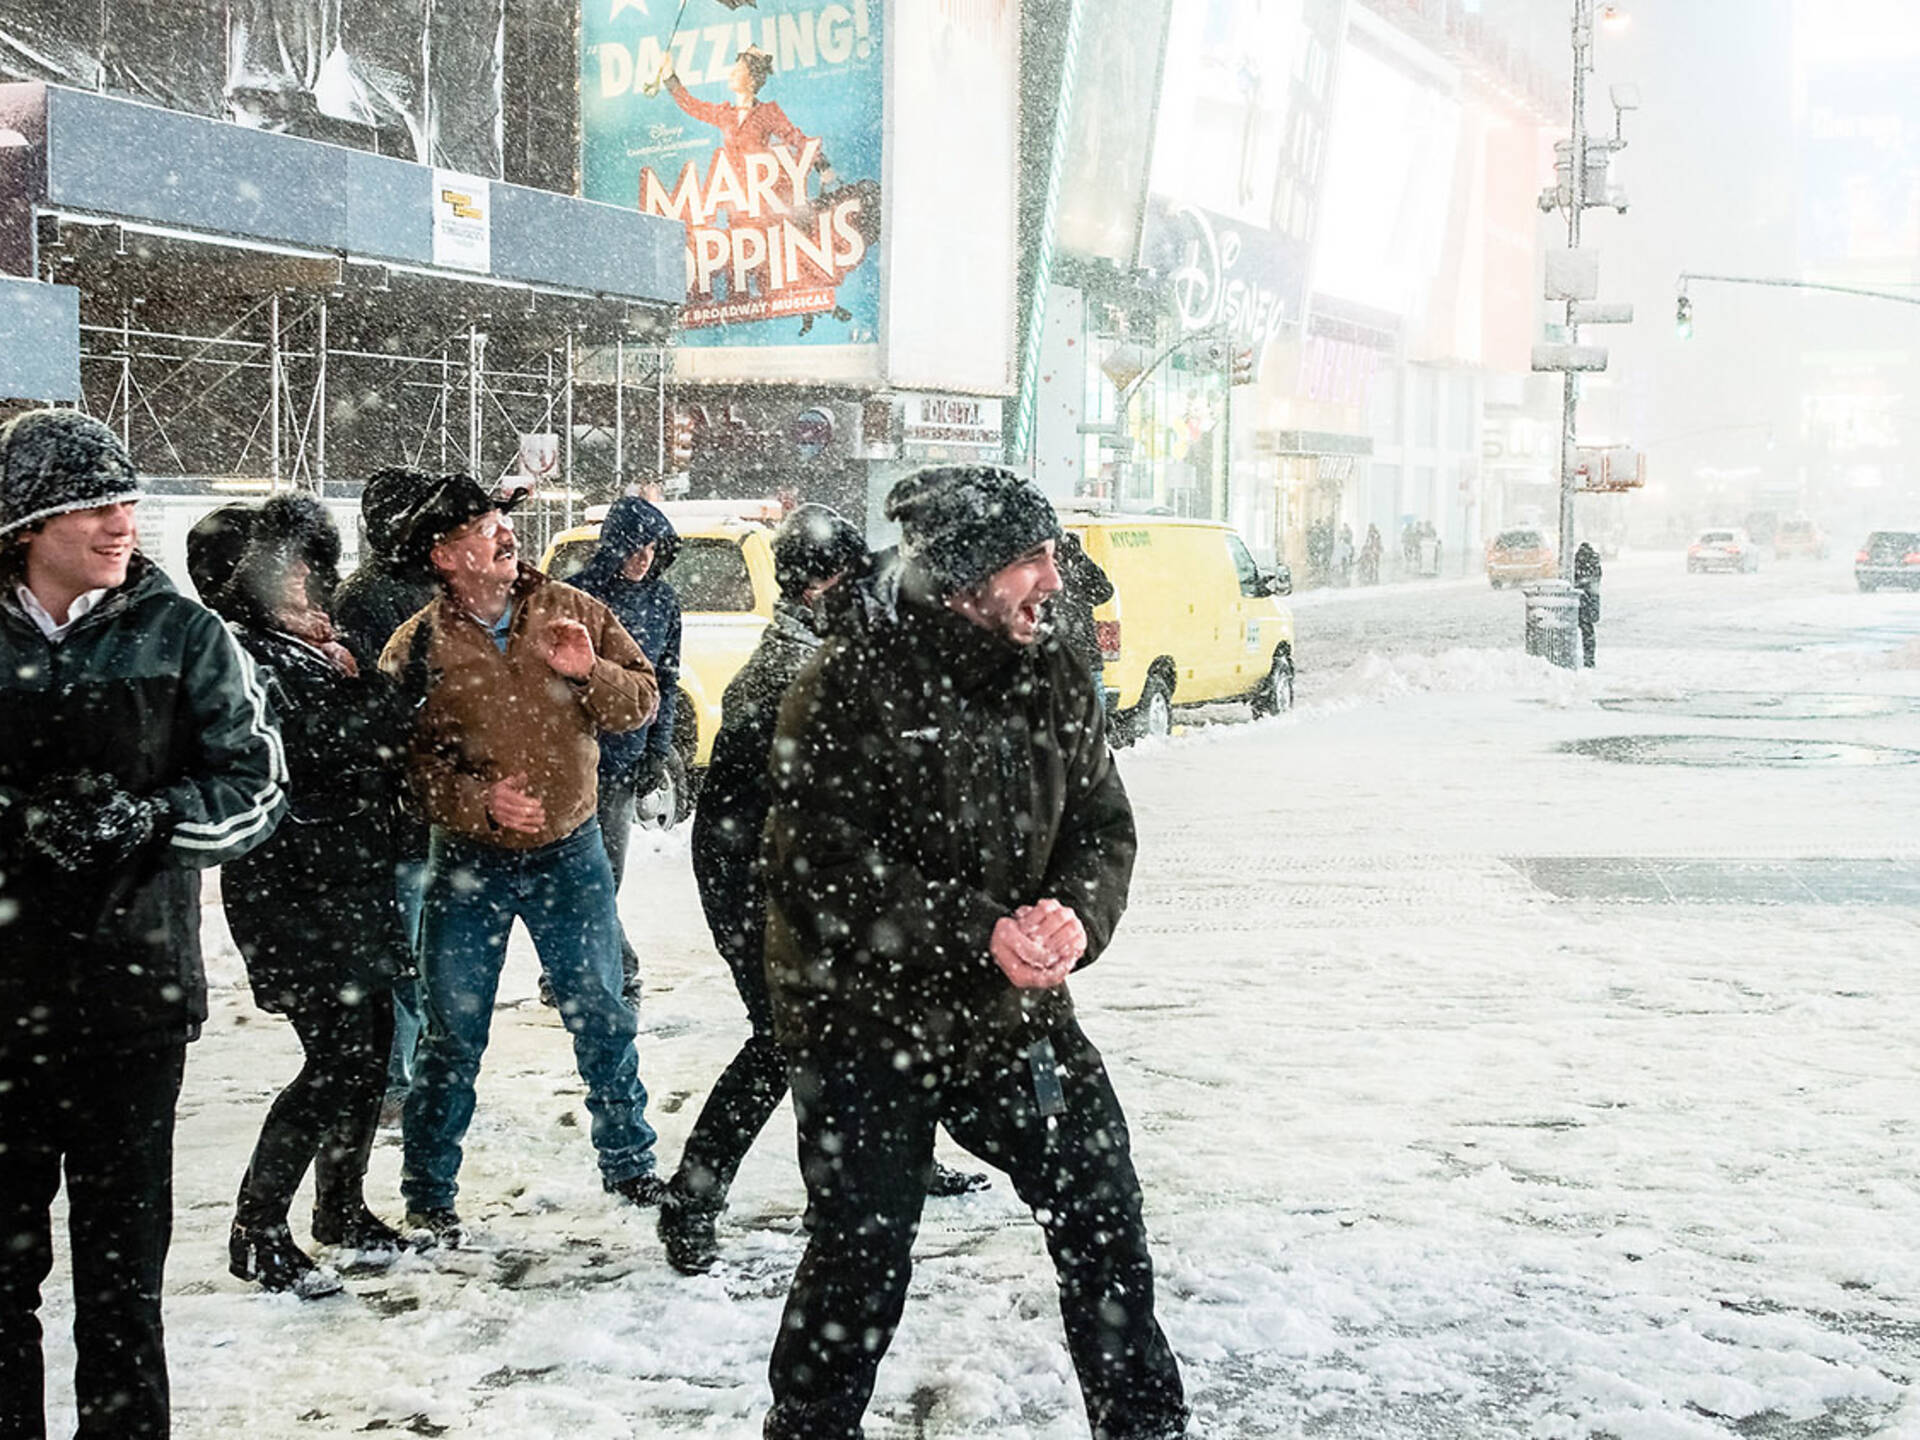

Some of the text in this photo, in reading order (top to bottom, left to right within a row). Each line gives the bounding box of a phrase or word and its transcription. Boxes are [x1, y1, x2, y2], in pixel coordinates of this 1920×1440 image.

[643, 139, 822, 226] MARY
[685, 198, 865, 293] PPINS
[693, 302, 768, 322] BROADWAY
[771, 293, 831, 312] MUSICAL
